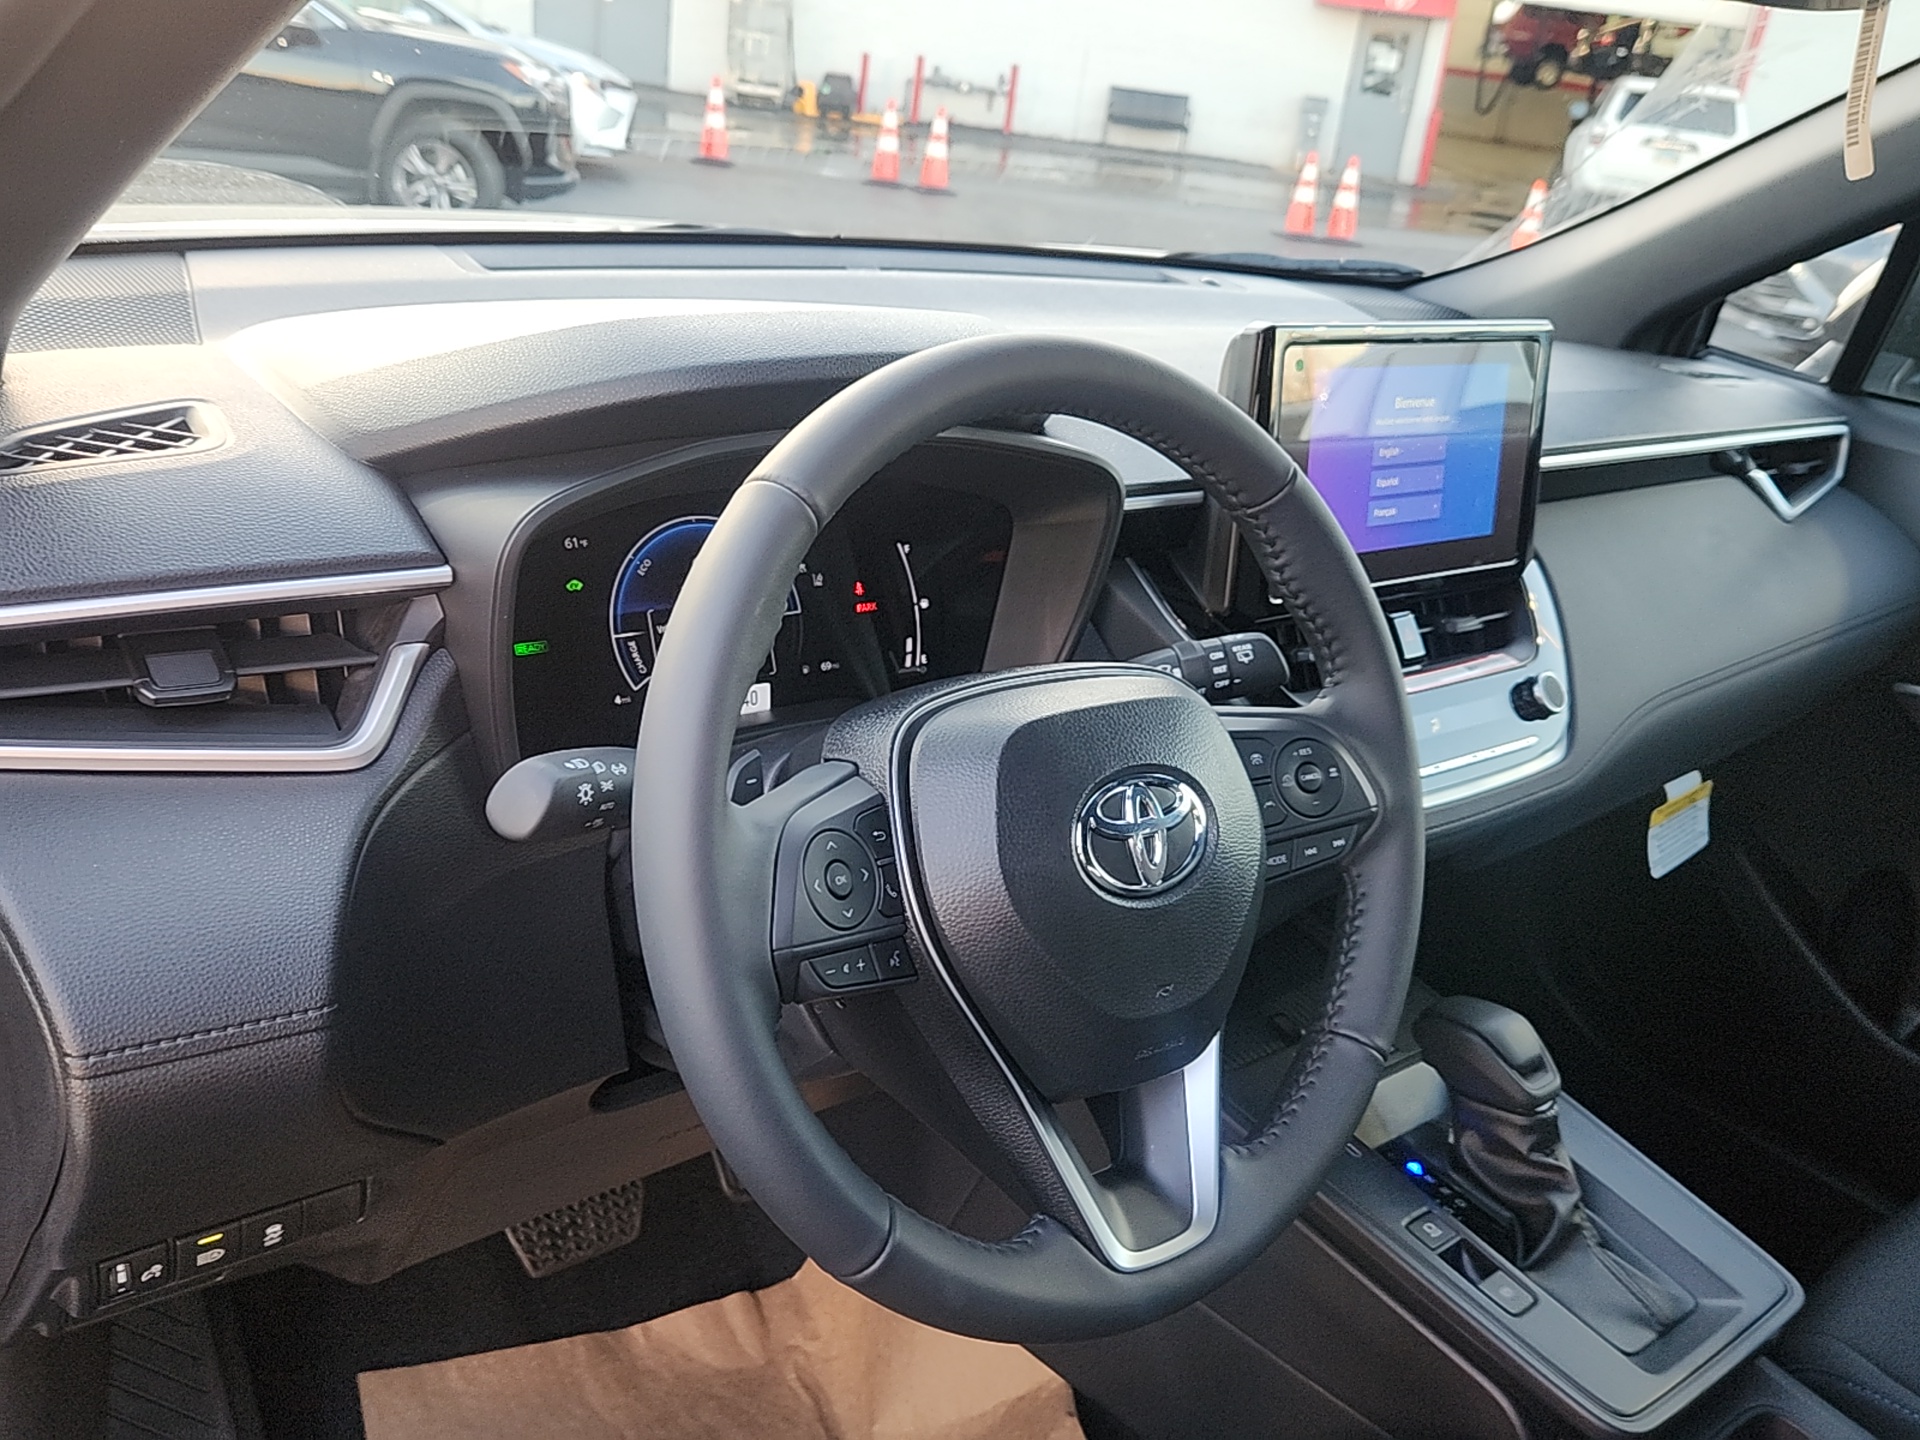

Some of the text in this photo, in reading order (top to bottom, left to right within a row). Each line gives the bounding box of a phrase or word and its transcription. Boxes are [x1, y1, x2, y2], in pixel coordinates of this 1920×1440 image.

[856, 602, 878, 613] PARK
[627, 640, 648, 674] CHARGE
[1214, 679, 1230, 688] OFF
